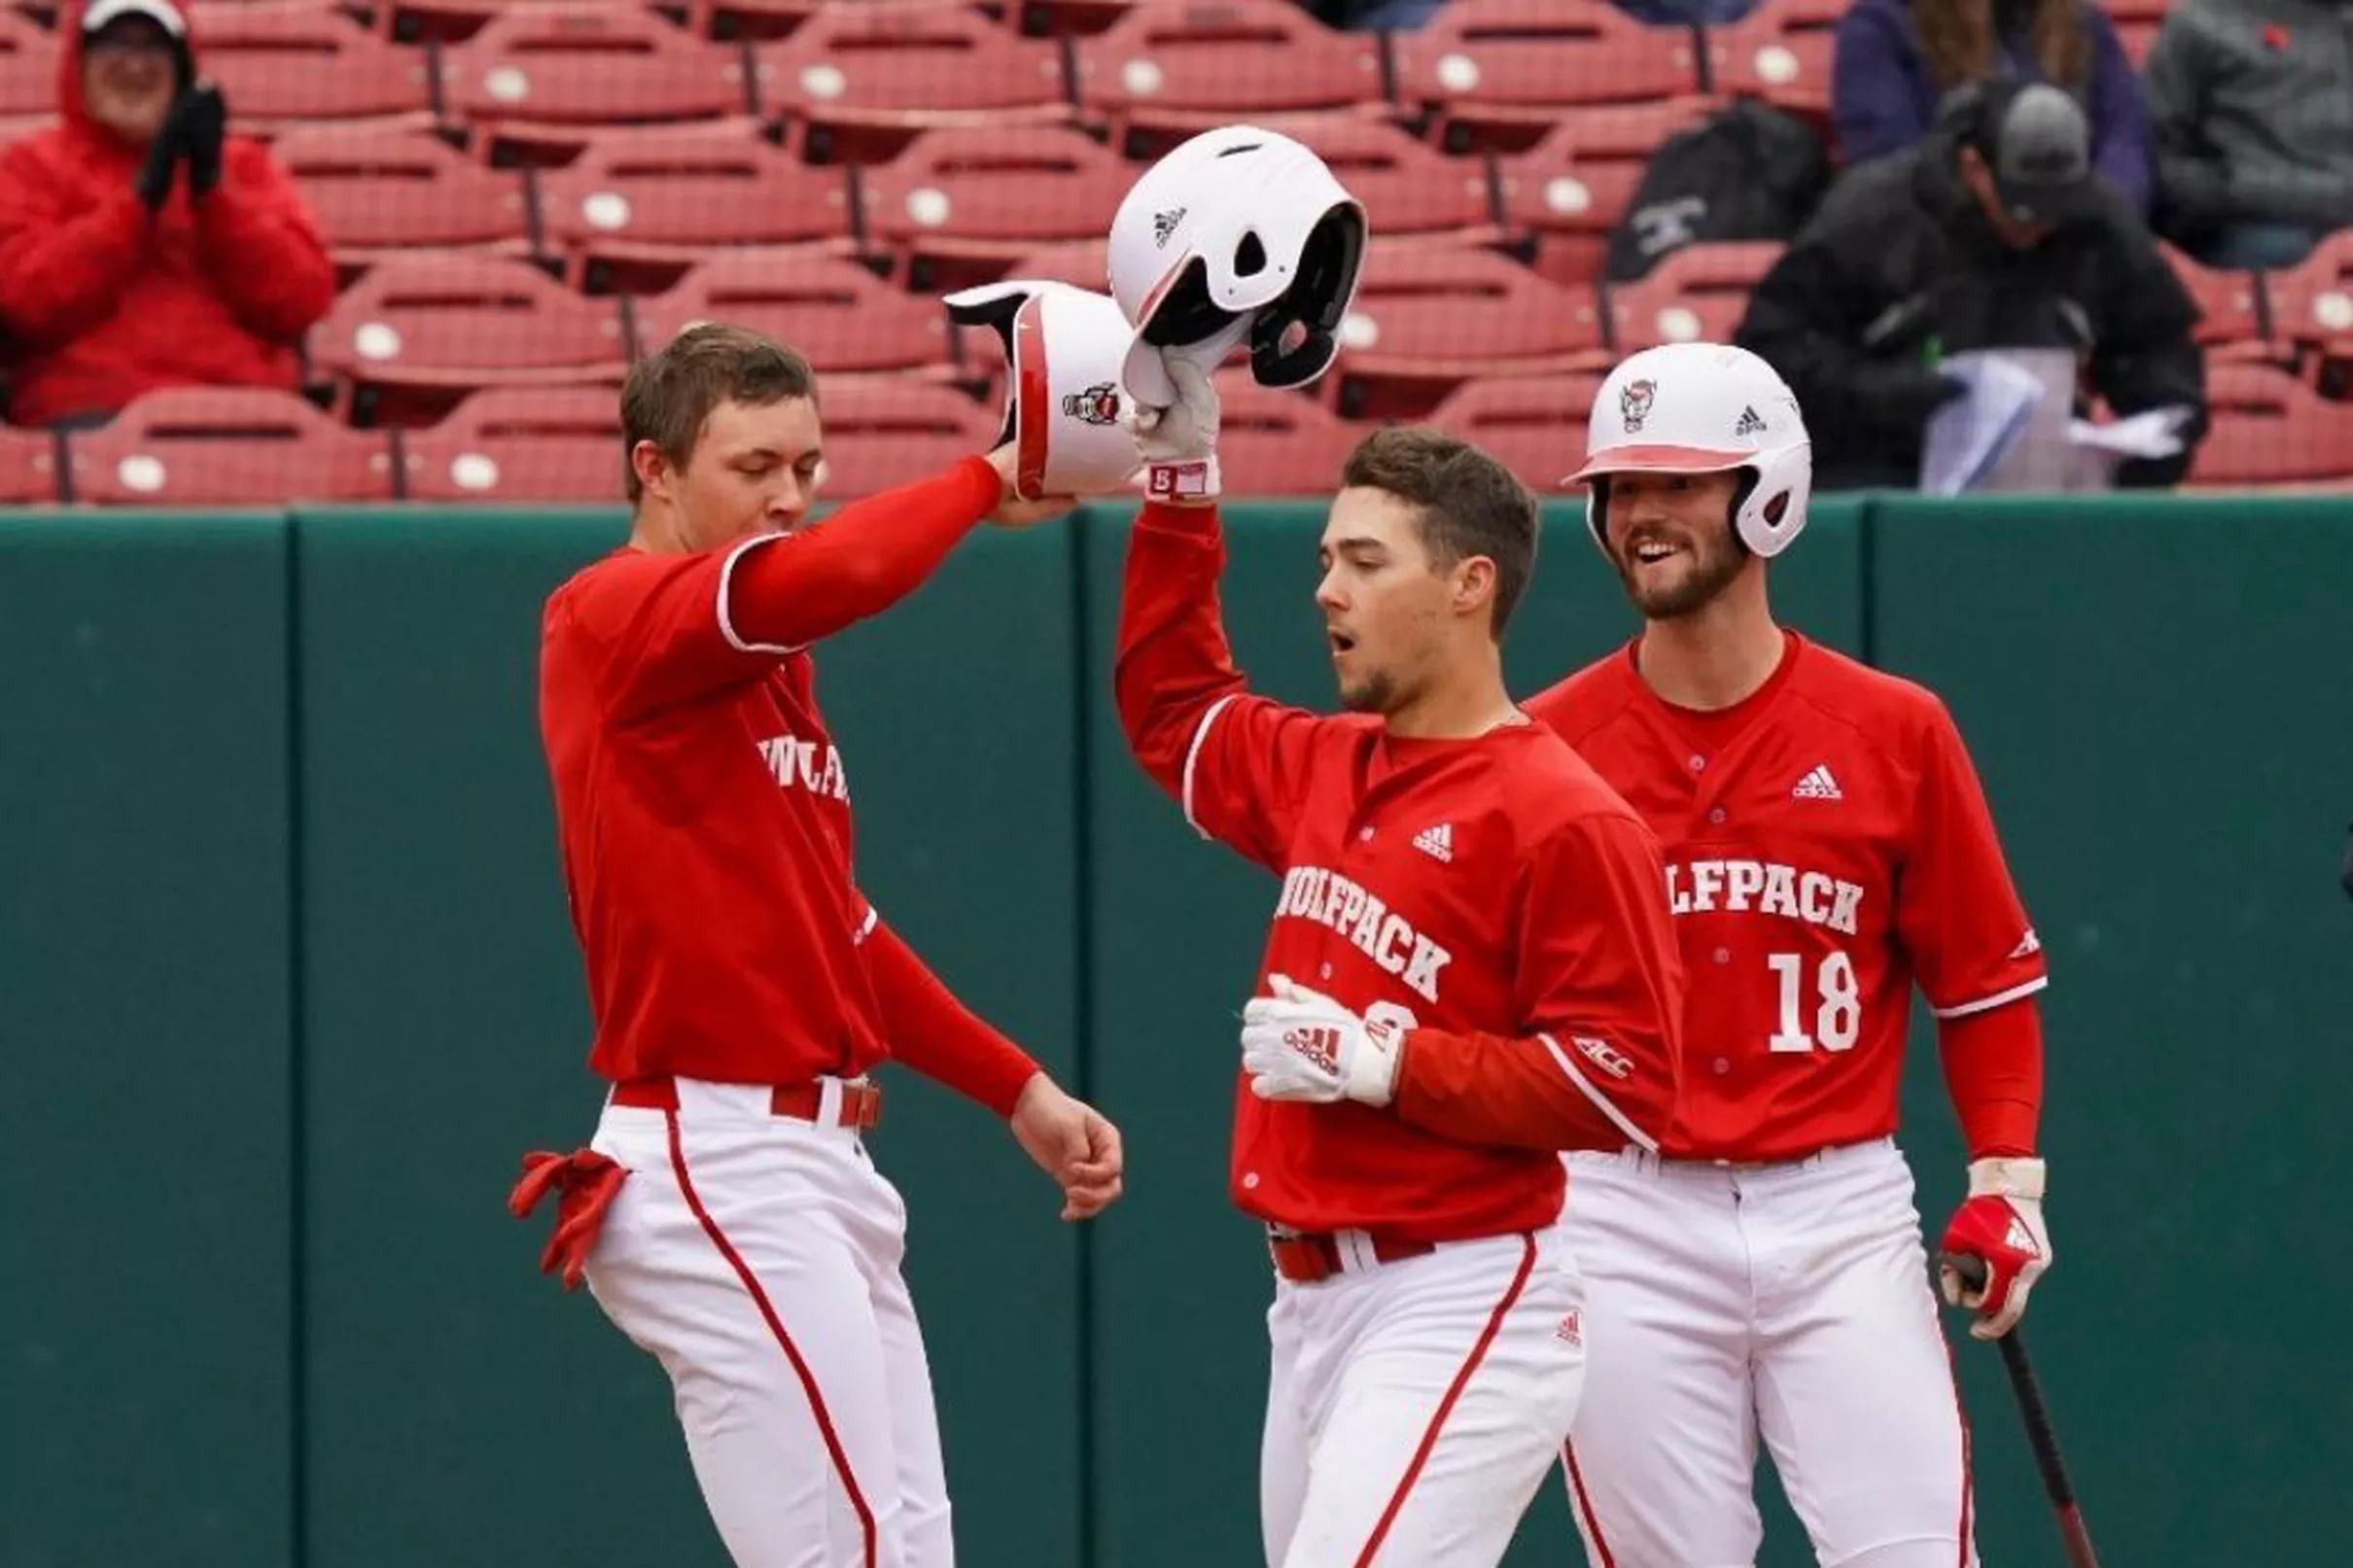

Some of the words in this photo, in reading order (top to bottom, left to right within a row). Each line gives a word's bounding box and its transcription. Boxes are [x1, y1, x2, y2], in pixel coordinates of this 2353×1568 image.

[1768, 951, 1862, 1053] 18
[1282, 1031, 1339, 1076] adidas
[1571, 1036, 1635, 1079] ACC
